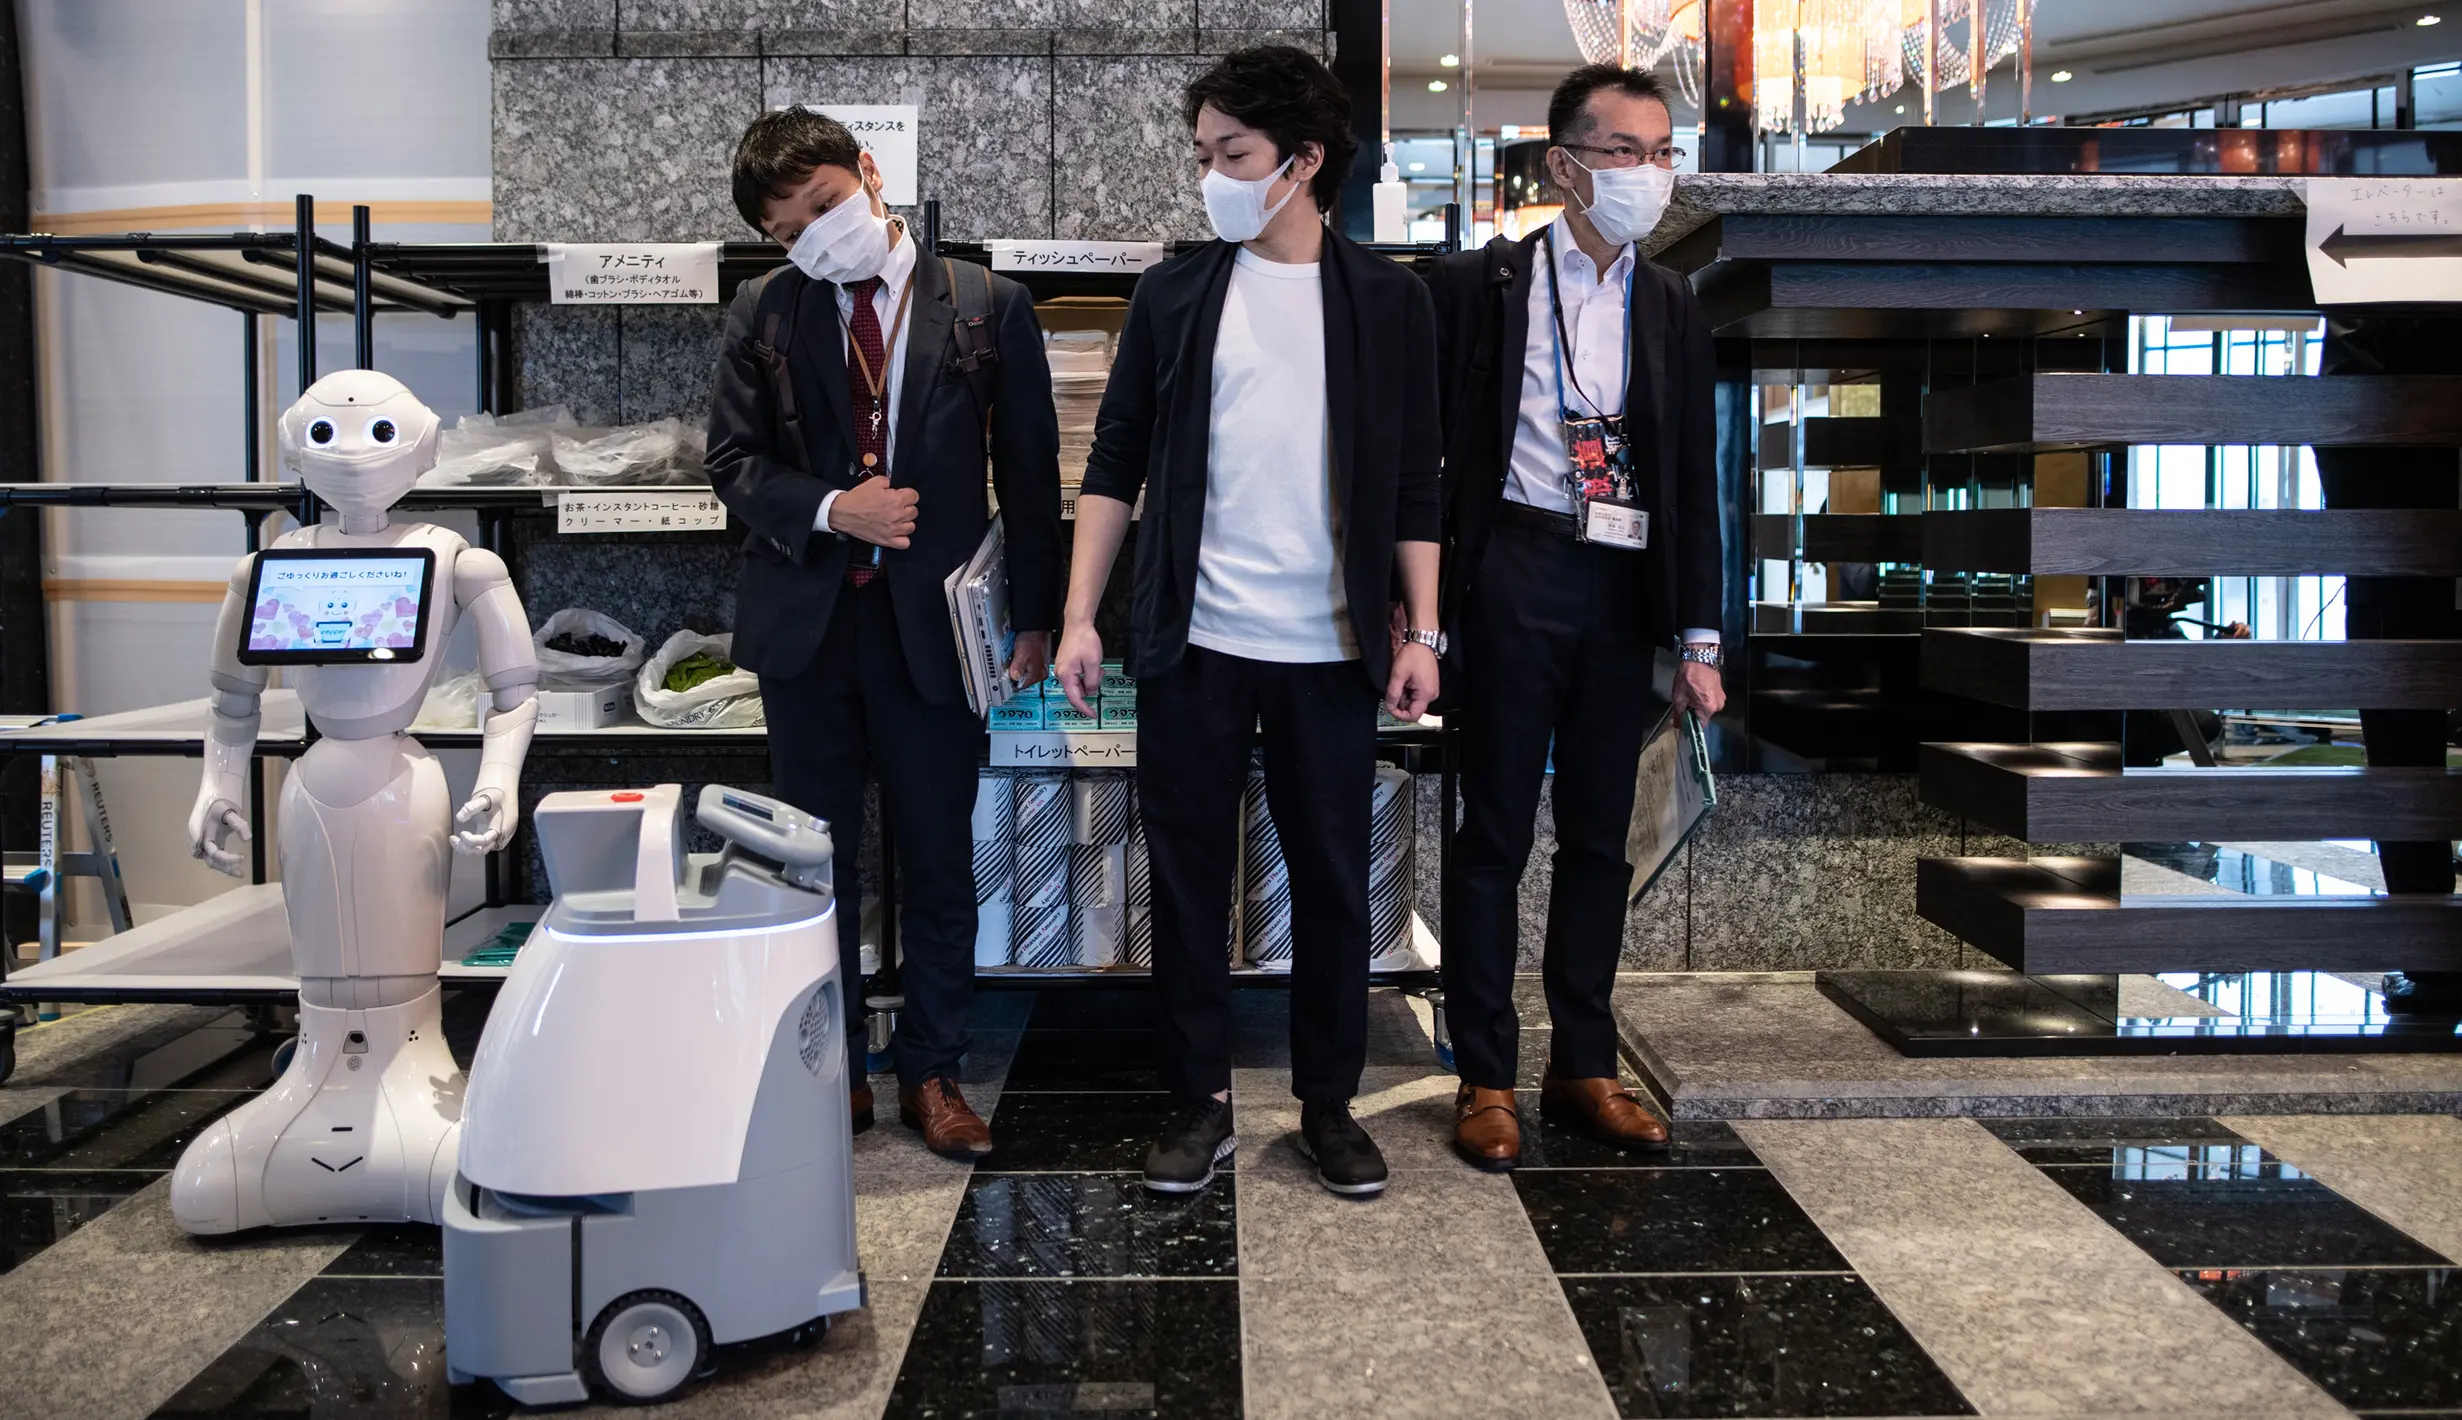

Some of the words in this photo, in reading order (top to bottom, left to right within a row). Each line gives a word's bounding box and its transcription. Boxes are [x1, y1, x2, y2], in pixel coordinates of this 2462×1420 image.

[2351, 184, 2445, 201] エレベーターは
[2373, 210, 2449, 227] こちらです。
[599, 254, 666, 269] アメニティ
[1013, 250, 1143, 266] ティッシュペーパー
[565, 501, 720, 513] お茶・インスタントコーヒー・砂糖
[1015, 744, 1137, 759] トイレットペーパー
[92, 782, 113, 843] REUTERS
[41, 801, 53, 868] REUTERS
